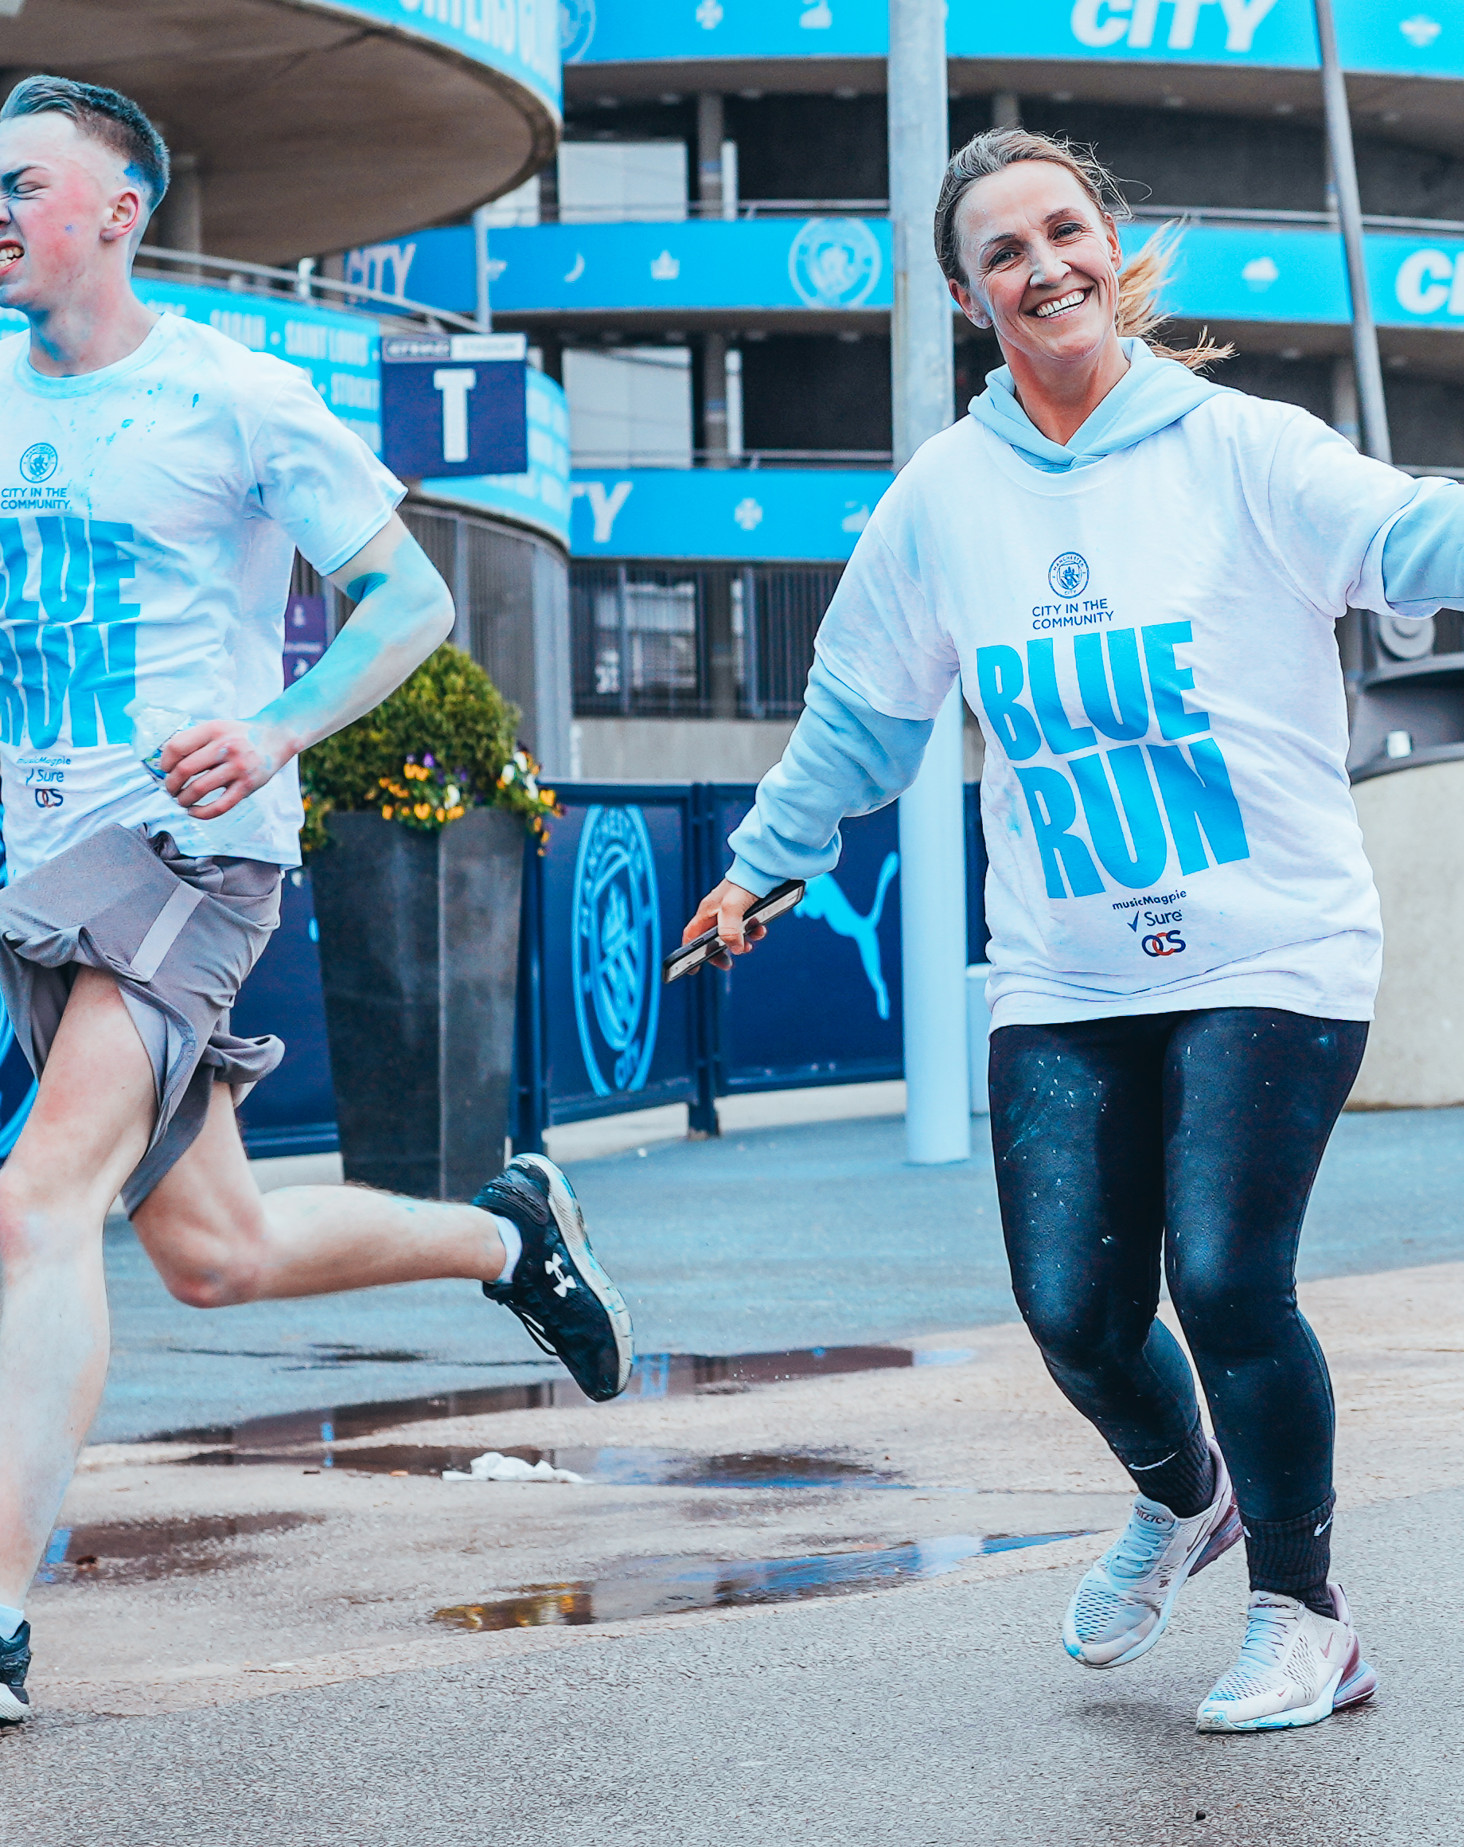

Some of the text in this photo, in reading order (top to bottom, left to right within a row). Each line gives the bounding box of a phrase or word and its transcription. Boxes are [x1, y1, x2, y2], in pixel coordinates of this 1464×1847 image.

[1071, 0, 1276, 53] CITY
[433, 368, 476, 463] T
[1, 487, 68, 498] CITY IN THE
[0, 499, 71, 510] COMMUNITY
[0, 516, 141, 624] LUE
[1032, 598, 1108, 617] CITY IN THE
[1032, 610, 1114, 630] COMMUNITY
[976, 620, 1210, 761] BLUE
[36, 768, 65, 783] Sure
[1013, 737, 1250, 899] RUN
[1112, 889, 1187, 910] musicMagpie
[1144, 910, 1182, 927] Sure
[1141, 929, 1186, 957] OCS
